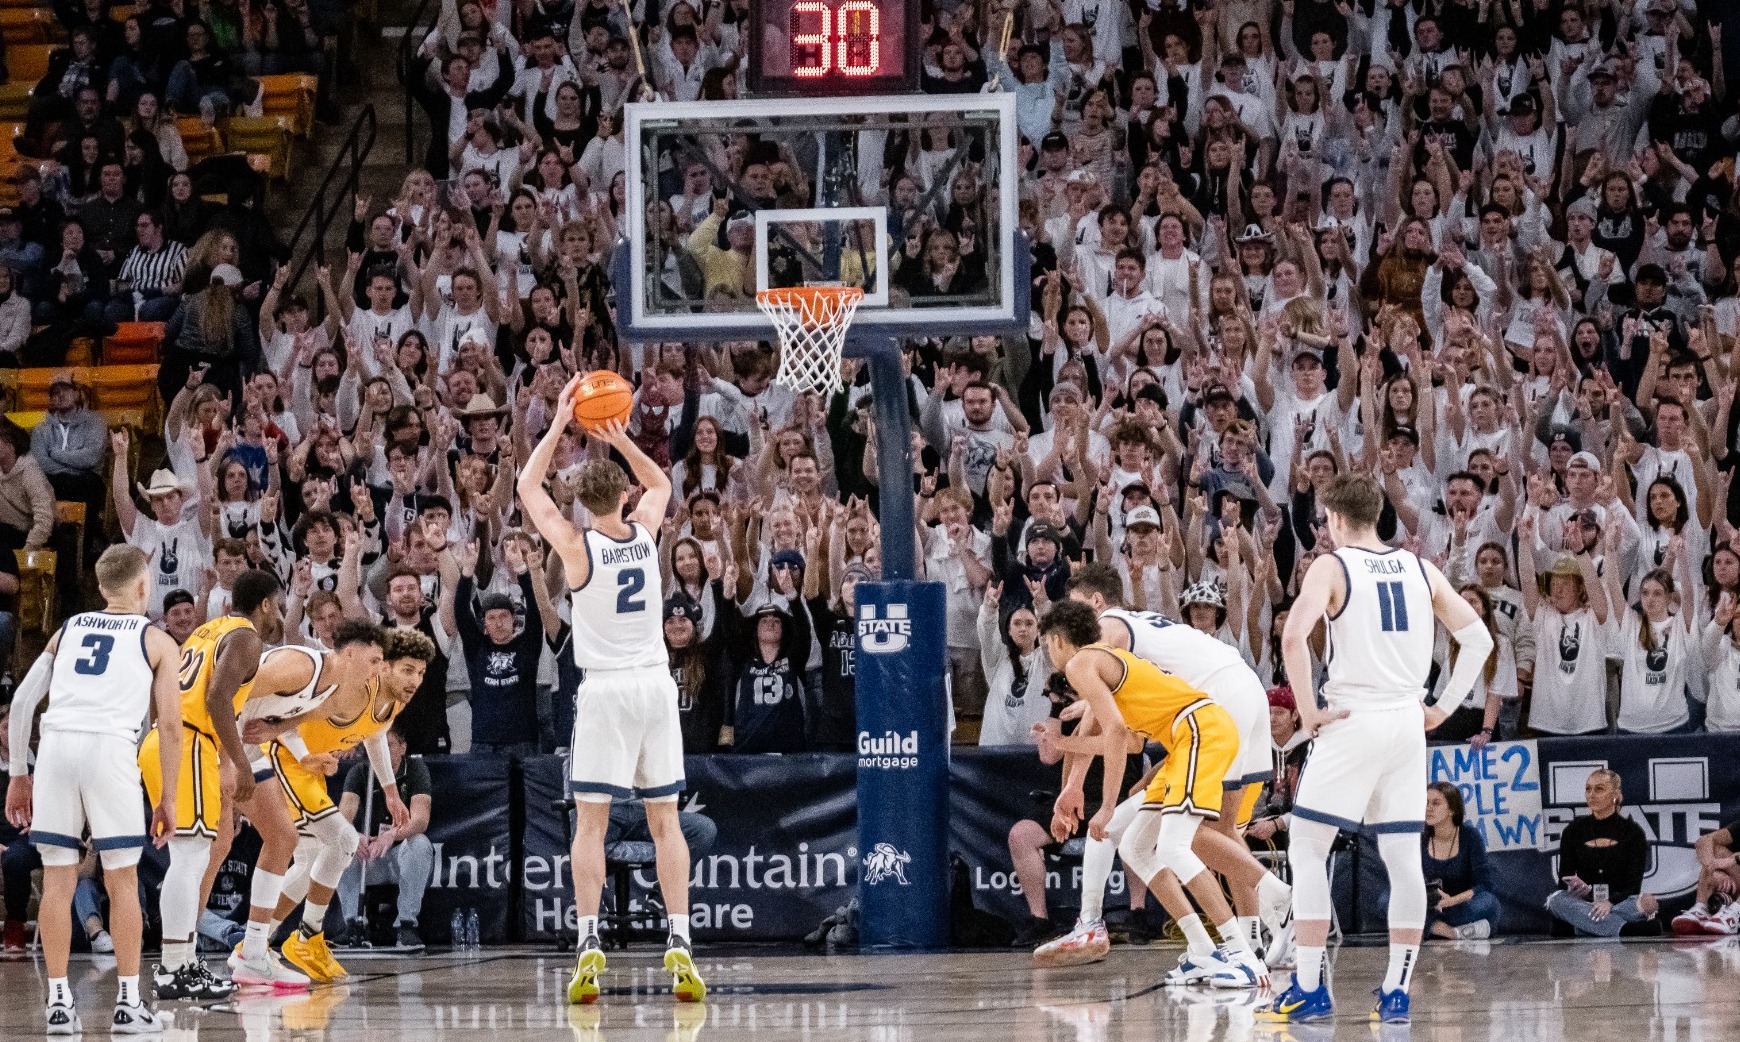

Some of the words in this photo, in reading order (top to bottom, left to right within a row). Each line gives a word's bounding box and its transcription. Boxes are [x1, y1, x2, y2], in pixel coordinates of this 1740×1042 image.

[794, 1, 879, 76] 30
[602, 542, 651, 564] BAIRSTOW
[1364, 559, 1406, 574] SHULGA
[617, 567, 645, 613] 2
[1376, 581, 1409, 631] 11
[74, 616, 138, 630] ASHWORTH
[858, 619, 911, 637] STATE
[74, 634, 115, 675] 3
[753, 673, 784, 704] 13
[858, 730, 918, 755] Guild
[858, 756, 918, 769] mortgage
[1431, 745, 1498, 785] AME
[1501, 745, 1538, 791] 2
[1493, 814, 1540, 847] WY
[976, 866, 1061, 895] Logn
